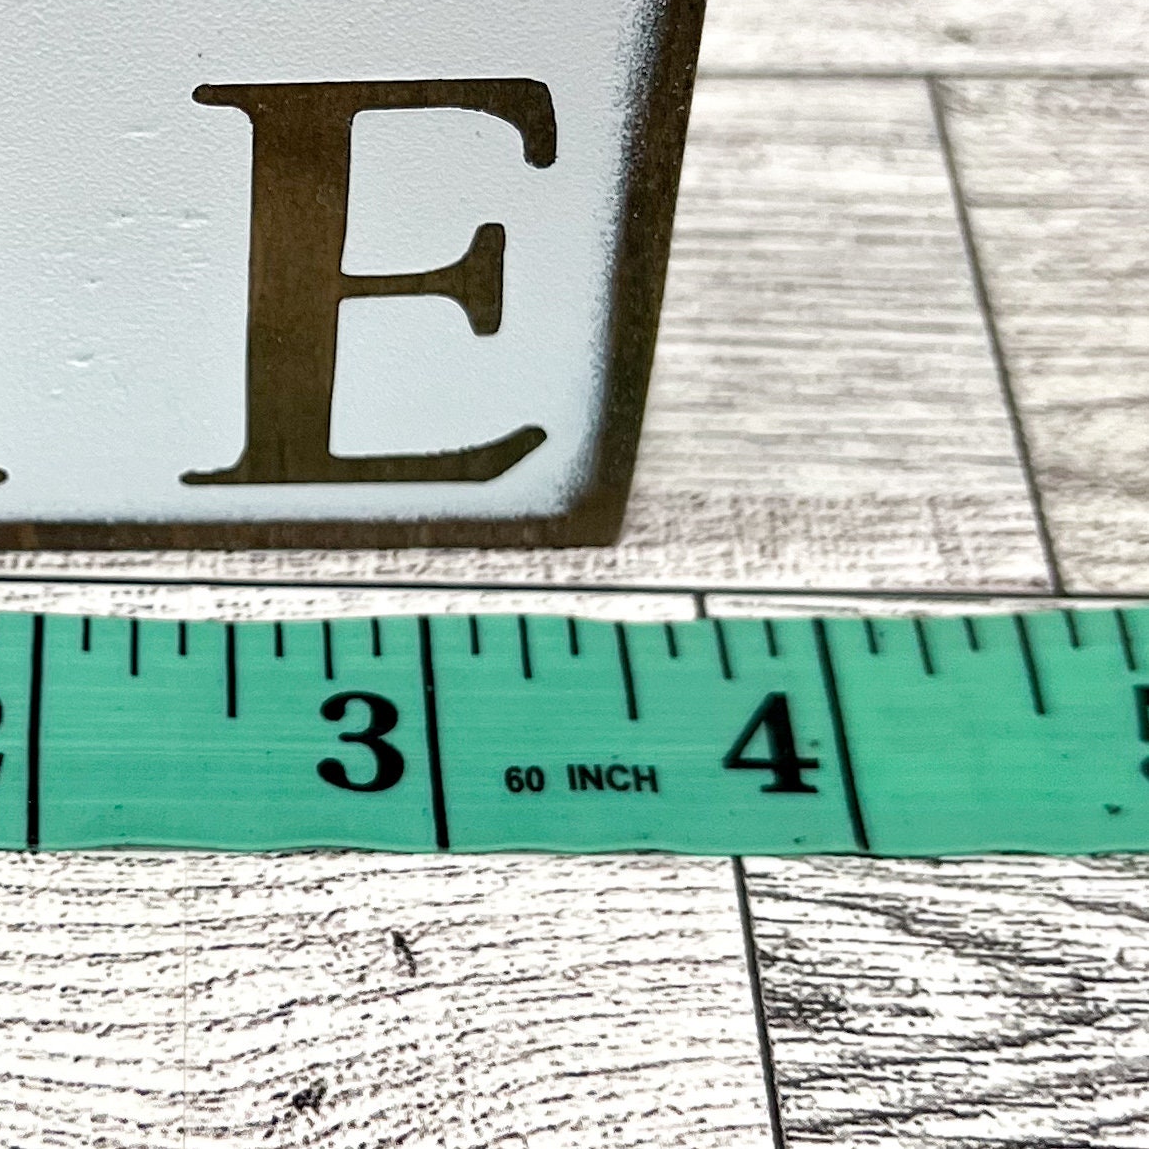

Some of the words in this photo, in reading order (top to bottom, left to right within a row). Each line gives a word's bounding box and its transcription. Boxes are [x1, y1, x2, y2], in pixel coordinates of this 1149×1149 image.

[316, 690, 406, 794] 3
[504, 765, 546, 794] 60
[566, 763, 660, 794] INCH
[721, 691, 821, 795] 4
